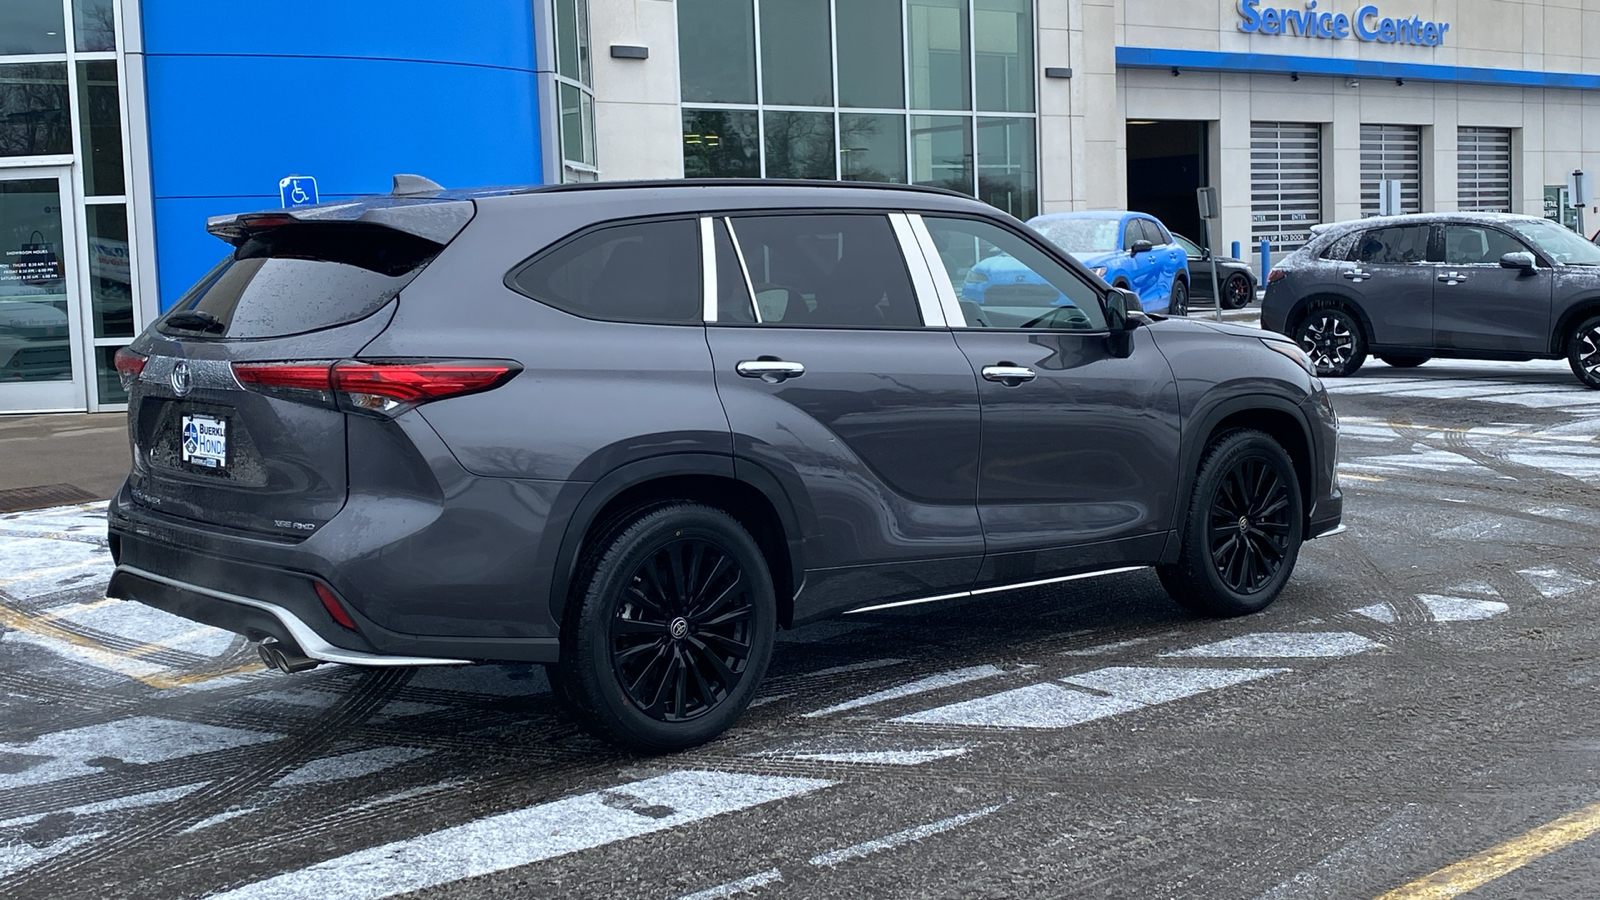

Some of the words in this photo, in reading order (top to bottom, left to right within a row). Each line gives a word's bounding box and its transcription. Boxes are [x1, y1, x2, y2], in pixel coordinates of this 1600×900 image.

[1238, 0, 1349, 39] Service
[1353, 5, 1450, 46] Center
[200, 423, 225, 437] BUERKL
